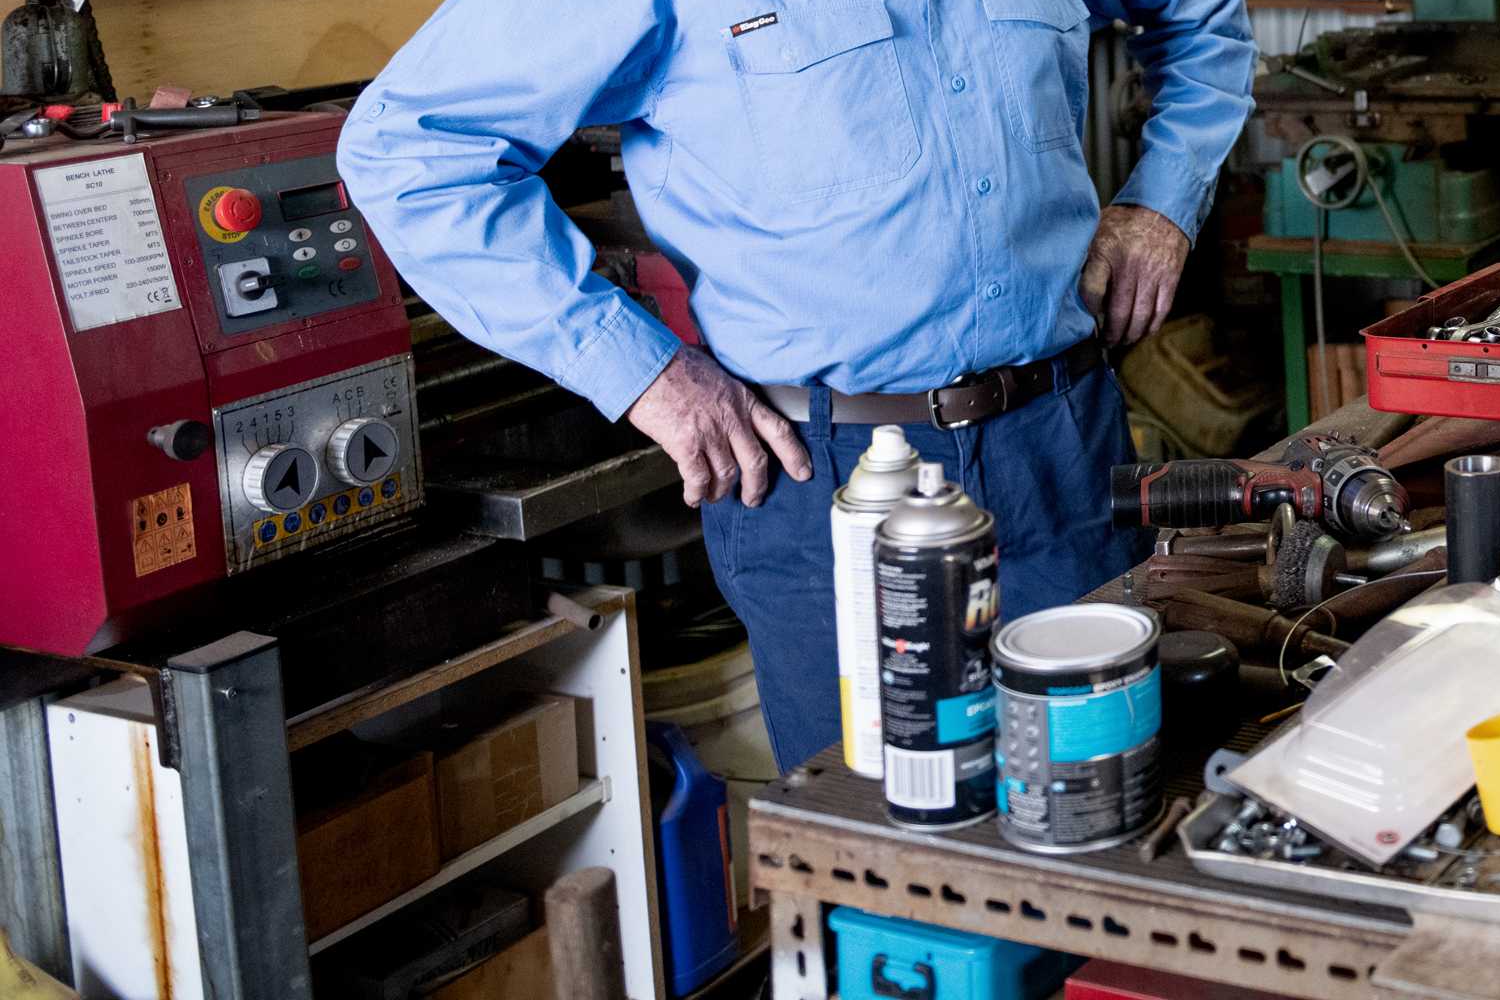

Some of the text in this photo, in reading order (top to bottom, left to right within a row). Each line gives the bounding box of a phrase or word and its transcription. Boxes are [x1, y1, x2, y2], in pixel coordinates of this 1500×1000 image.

[65, 168, 115, 182] BENCH LATHE
[333, 385, 364, 404] A C B
[236, 406, 295, 433] 2 4 1 5 3
